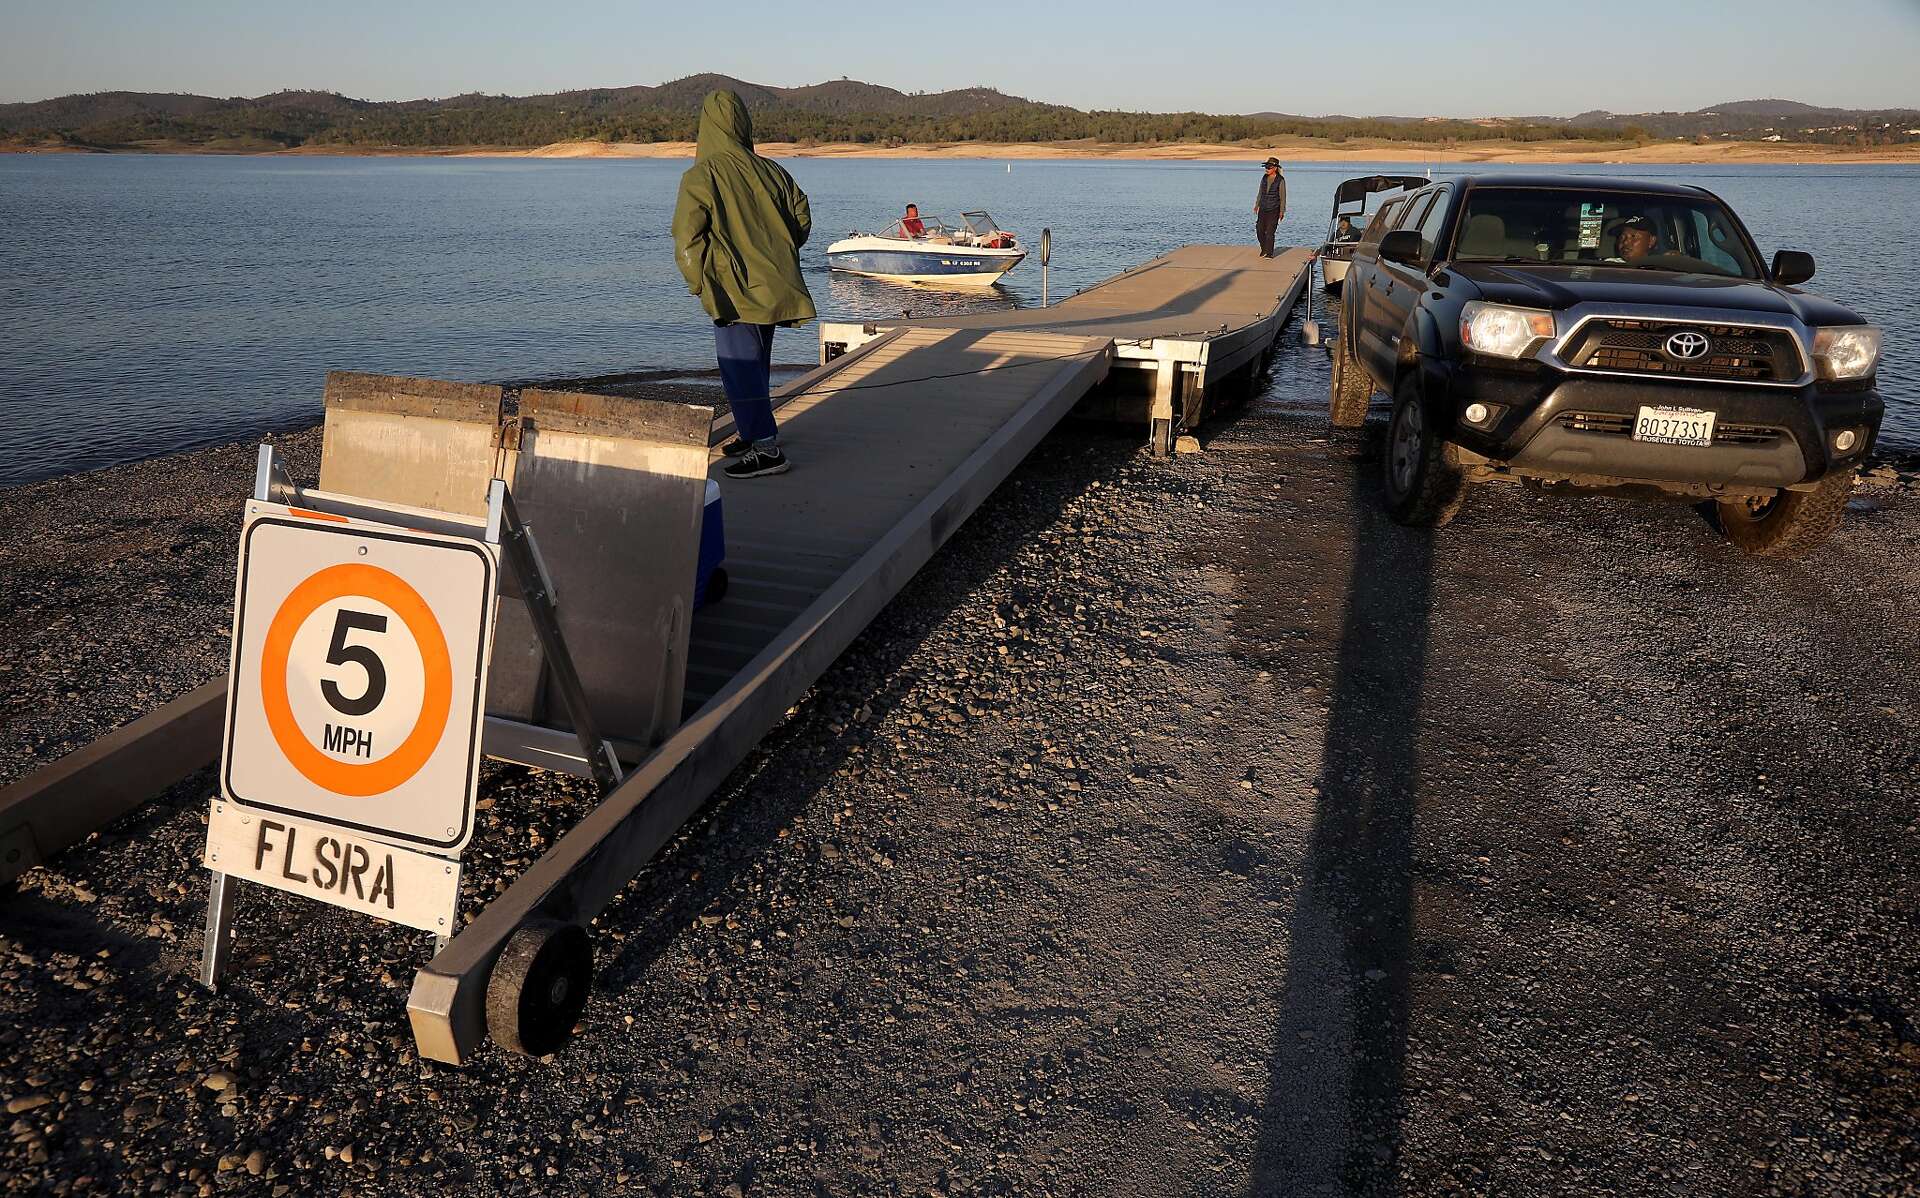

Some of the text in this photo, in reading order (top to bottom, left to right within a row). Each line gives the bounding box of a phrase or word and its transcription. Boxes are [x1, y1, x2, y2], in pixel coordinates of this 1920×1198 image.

[1639, 418, 1707, 440] 80373S1
[320, 609, 387, 716] 5
[323, 723, 372, 759] MPH
[254, 820, 395, 909] FLSRA
